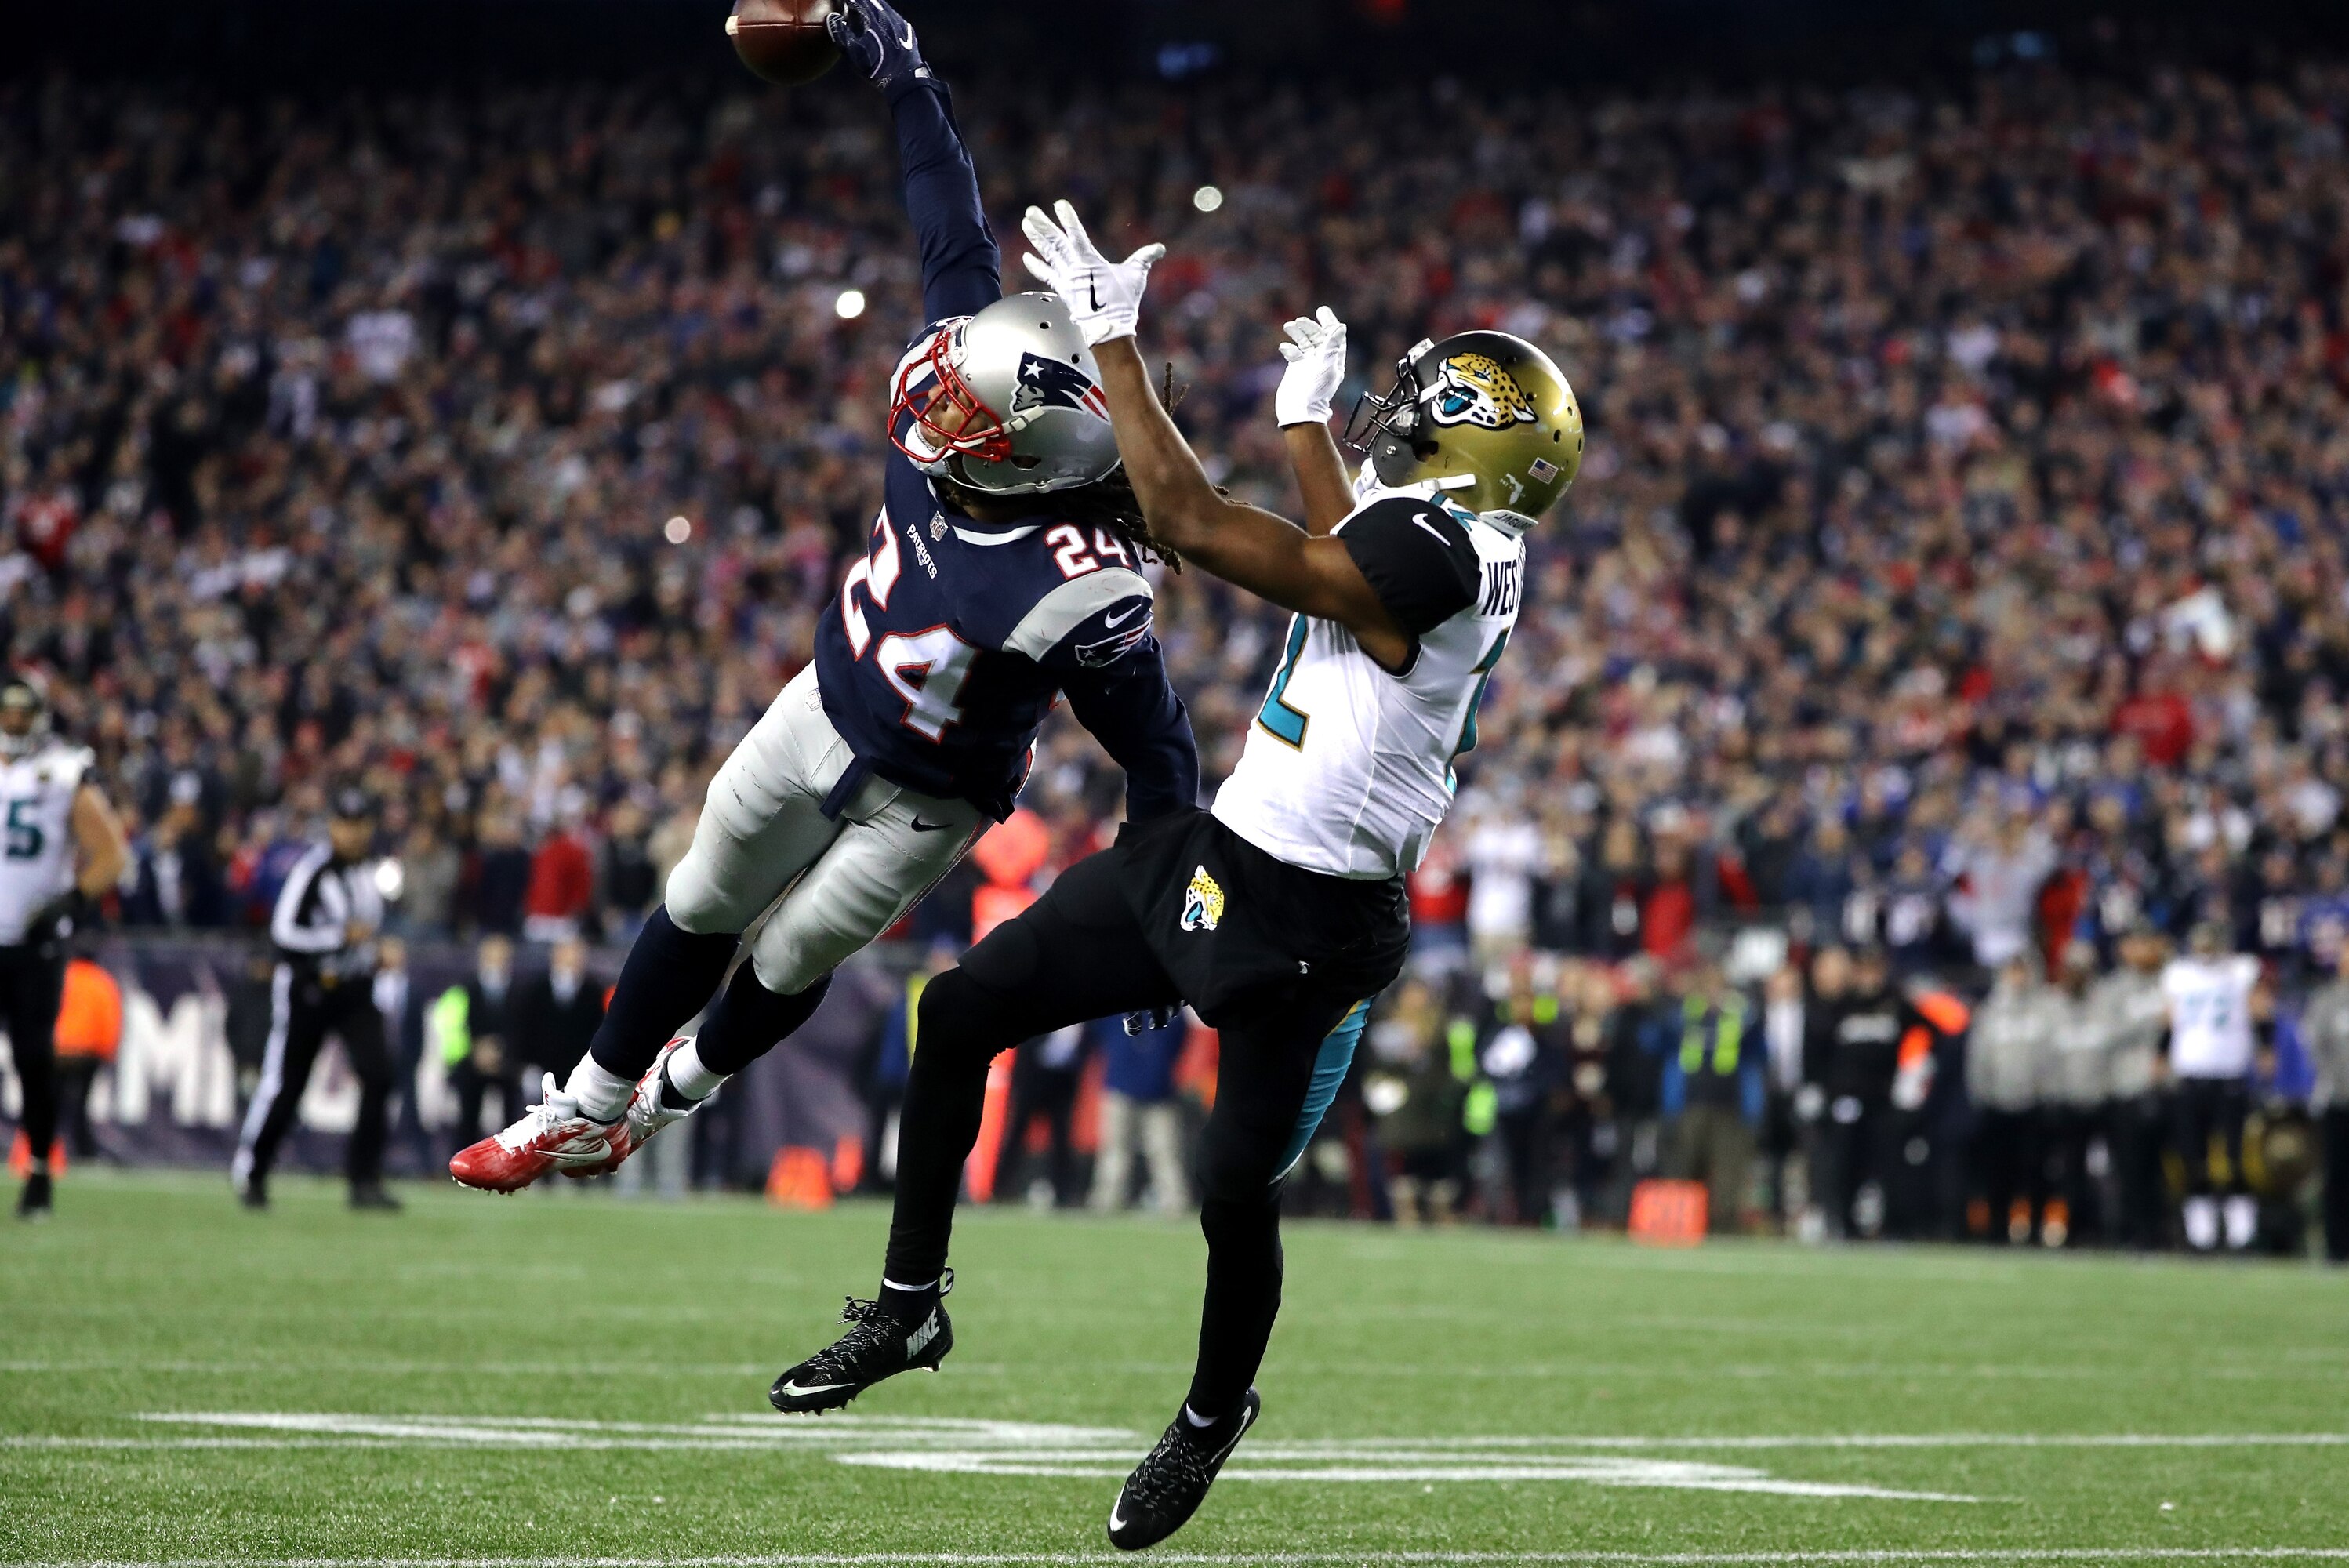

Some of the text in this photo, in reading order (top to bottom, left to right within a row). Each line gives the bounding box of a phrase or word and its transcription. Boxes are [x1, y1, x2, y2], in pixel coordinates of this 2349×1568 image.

[906, 523, 938, 579] PATRIOTS
[1044, 521, 1133, 580] 24
[841, 502, 982, 745] 24
[6, 797, 45, 860] 5
[906, 1306, 940, 1362] NIKE
